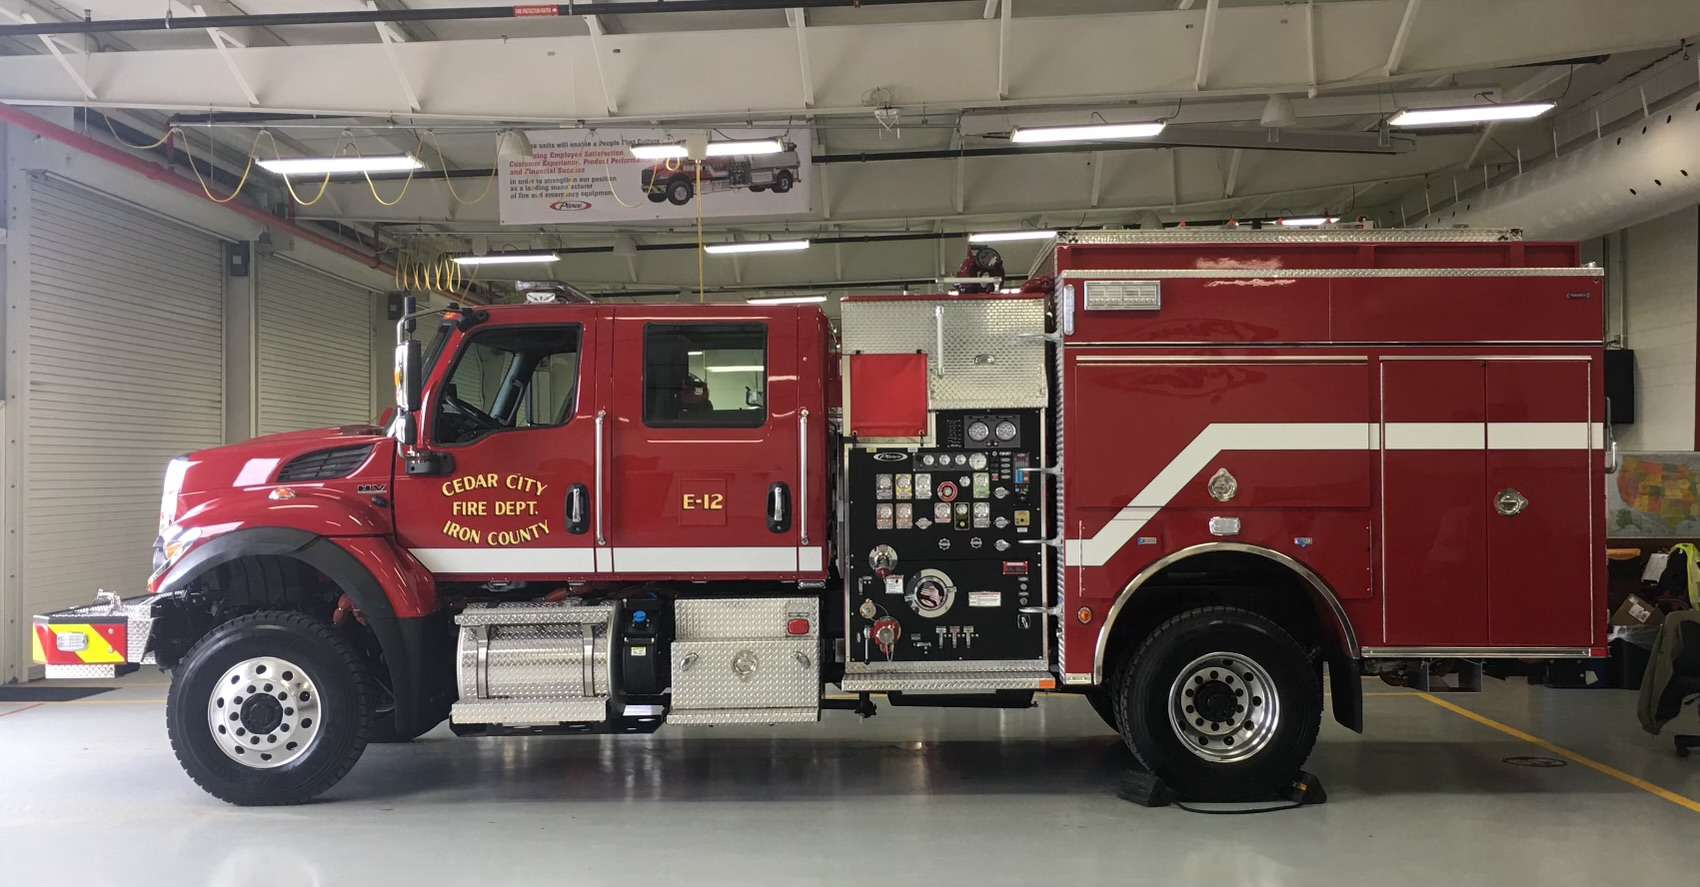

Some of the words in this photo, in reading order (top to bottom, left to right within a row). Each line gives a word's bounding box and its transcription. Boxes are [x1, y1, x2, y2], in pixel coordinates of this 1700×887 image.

[550, 151, 582, 160] Employee
[509, 160, 541, 168] Customer
[510, 168, 523, 176] and
[442, 473, 498, 496] CEDAR
[506, 475, 548, 496] CITY
[453, 501, 487, 516] FIRE
[495, 501, 538, 515] DEPT.
[683, 493, 724, 510] E-12
[443, 520, 481, 544] IRON
[488, 519, 550, 545] COUNTY
